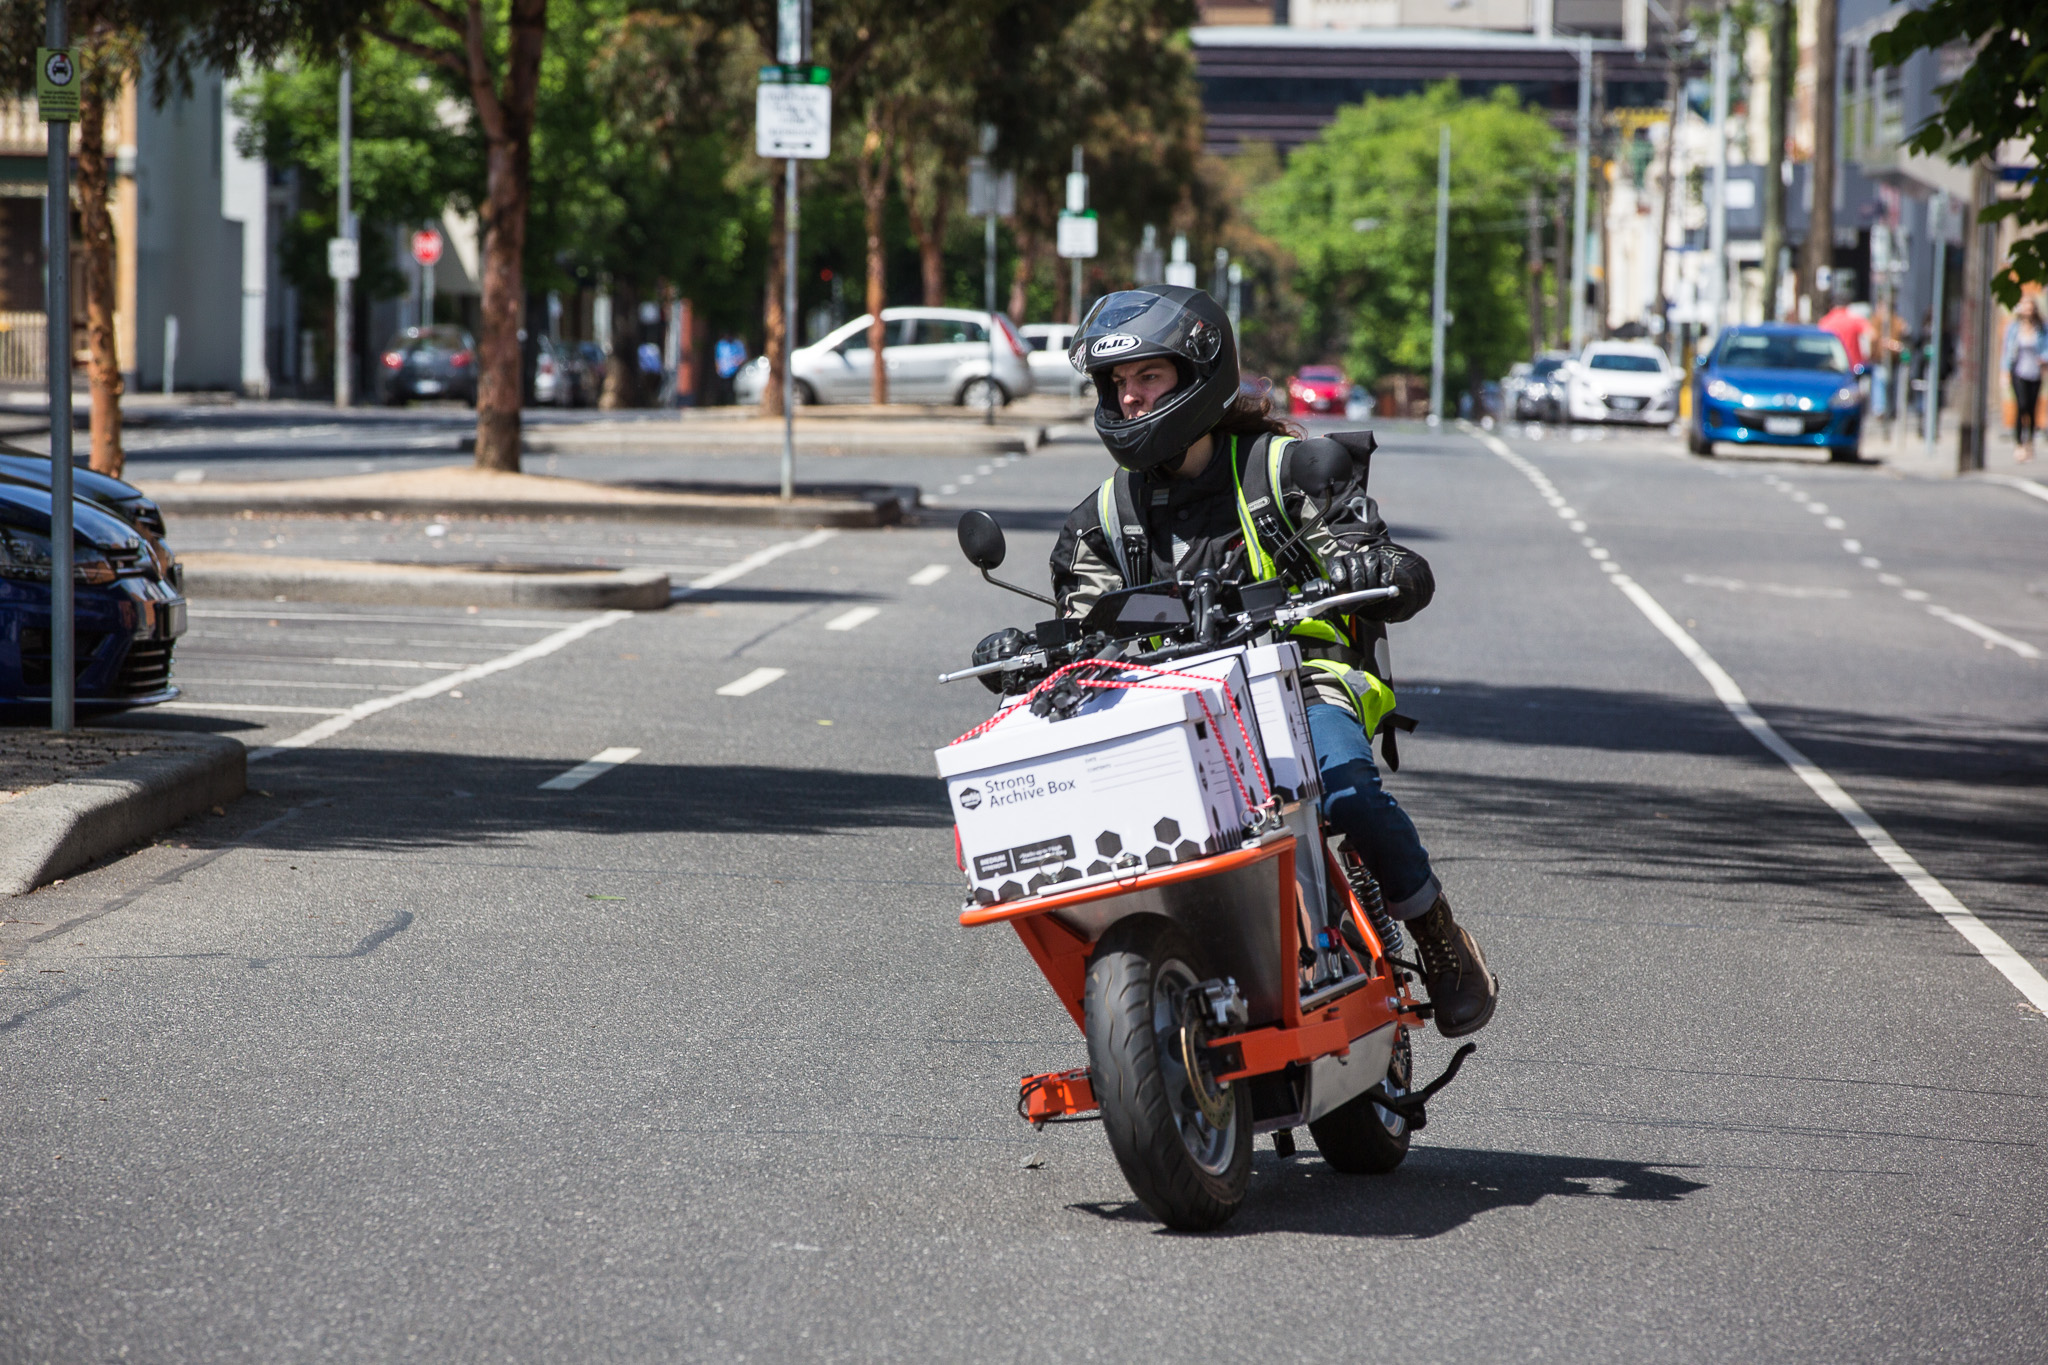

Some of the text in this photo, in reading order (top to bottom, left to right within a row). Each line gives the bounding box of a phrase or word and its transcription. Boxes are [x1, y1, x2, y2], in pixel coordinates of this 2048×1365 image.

[1096, 338, 1131, 352] HJC
[985, 774, 1036, 794] Strong
[990, 787, 1044, 808] Archive
[1047, 779, 1077, 794] Box
